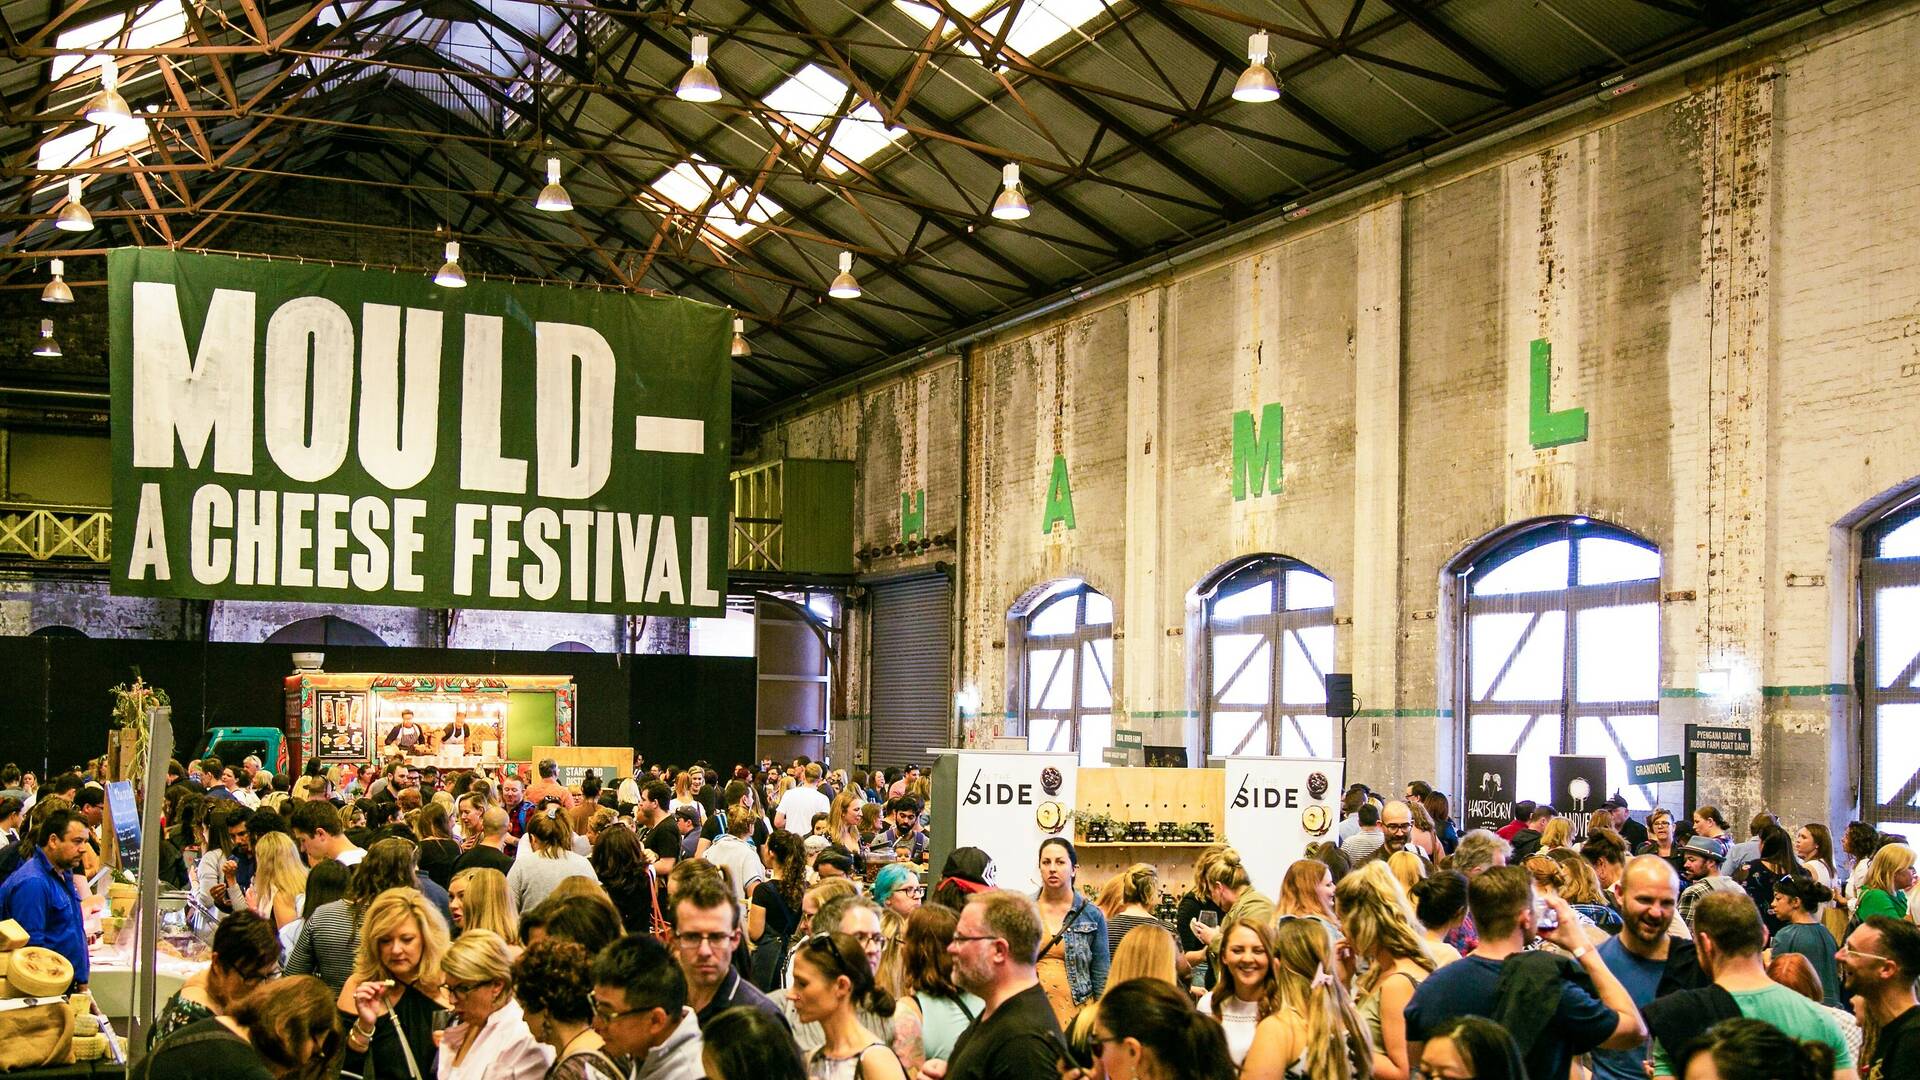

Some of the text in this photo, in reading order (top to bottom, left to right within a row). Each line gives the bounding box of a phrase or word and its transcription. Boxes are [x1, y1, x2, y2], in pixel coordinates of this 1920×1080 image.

[1042, 454, 1076, 534] A
[1232, 402, 1283, 501] M
[1529, 338, 1589, 450] L
[128, 482, 719, 607] A CHEESE FESTIVAL
[1706, 740, 1720, 749] FARM
[1721, 741, 1734, 750] GOAT
[1734, 742, 1750, 751] DAIRY
[1722, 731, 1737, 740] DAIRY
[566, 767, 603, 777] STARRD
[1635, 762, 1671, 776] GRANDVEWE
[964, 782, 1032, 805] SIDE
[1231, 786, 1298, 809] SIDE
[1468, 799, 1513, 820] HARTSHORN
